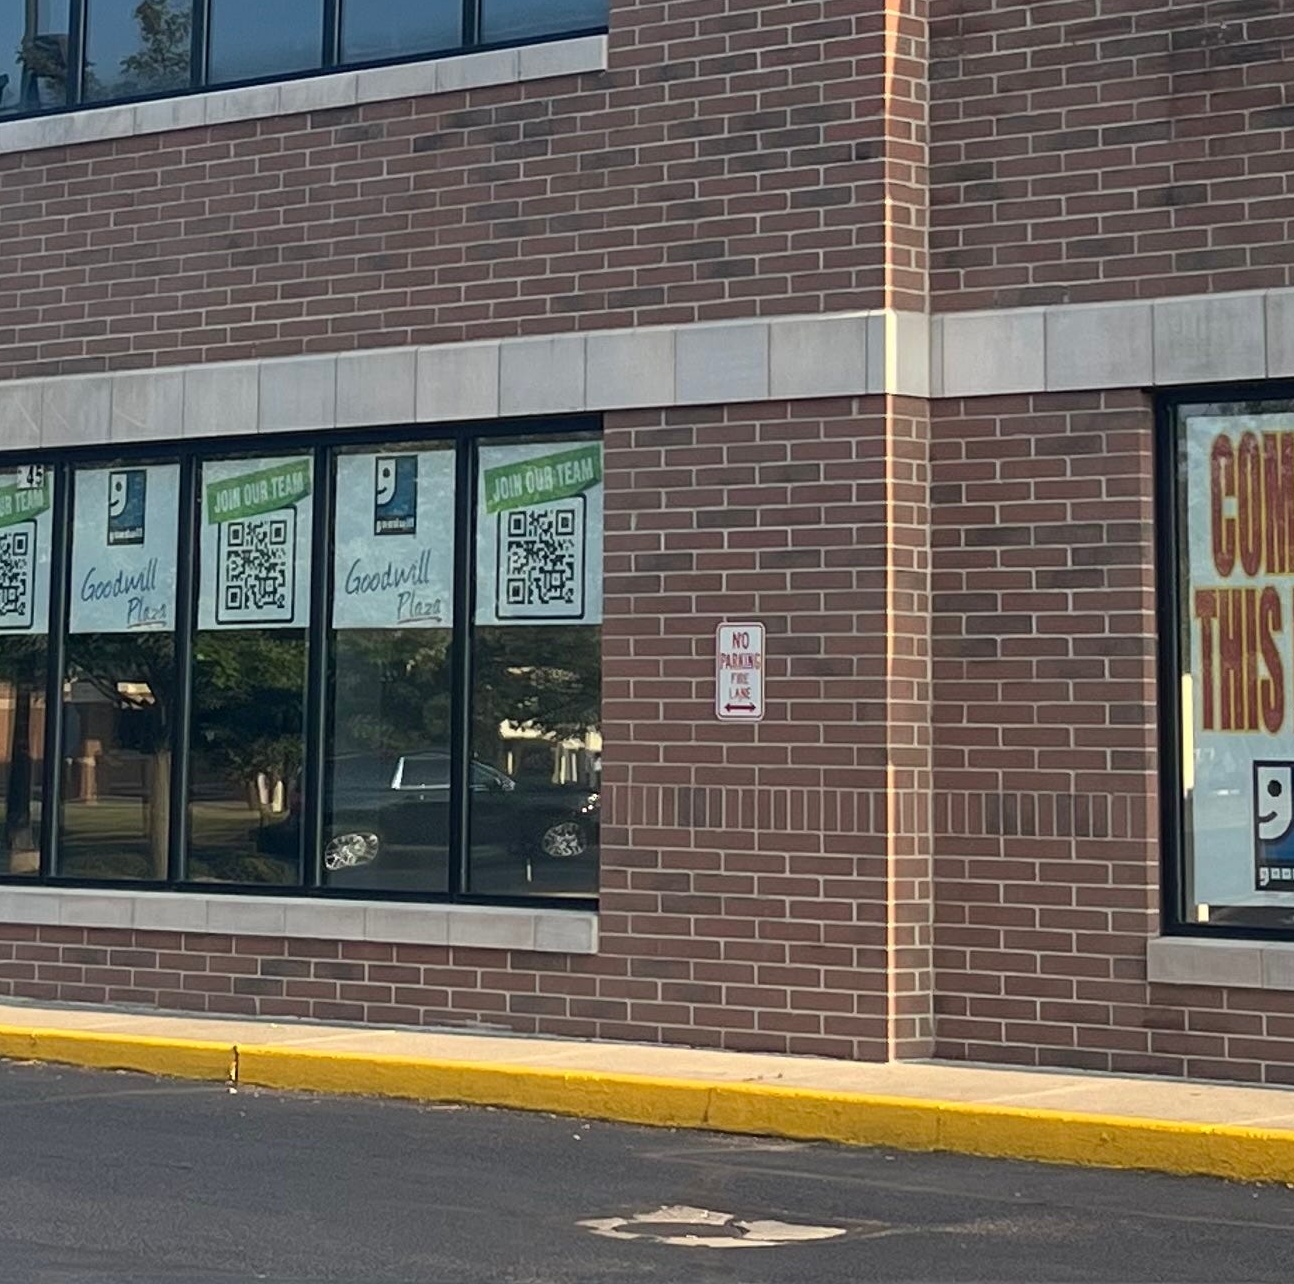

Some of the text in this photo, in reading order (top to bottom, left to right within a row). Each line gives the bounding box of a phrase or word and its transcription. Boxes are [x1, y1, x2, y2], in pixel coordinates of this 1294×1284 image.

[214, 471, 304, 513] JOIN OUR TEAM
[492, 457, 595, 503] JOIN OUR TEAM
[81, 557, 158, 602] Goodwill
[345, 548, 432, 595] Goodwill
[397, 591, 441, 617] Plaza
[732, 631, 750, 650] NO
[1194, 585, 1286, 735] THIS
[729, 686, 752, 700] LANE
